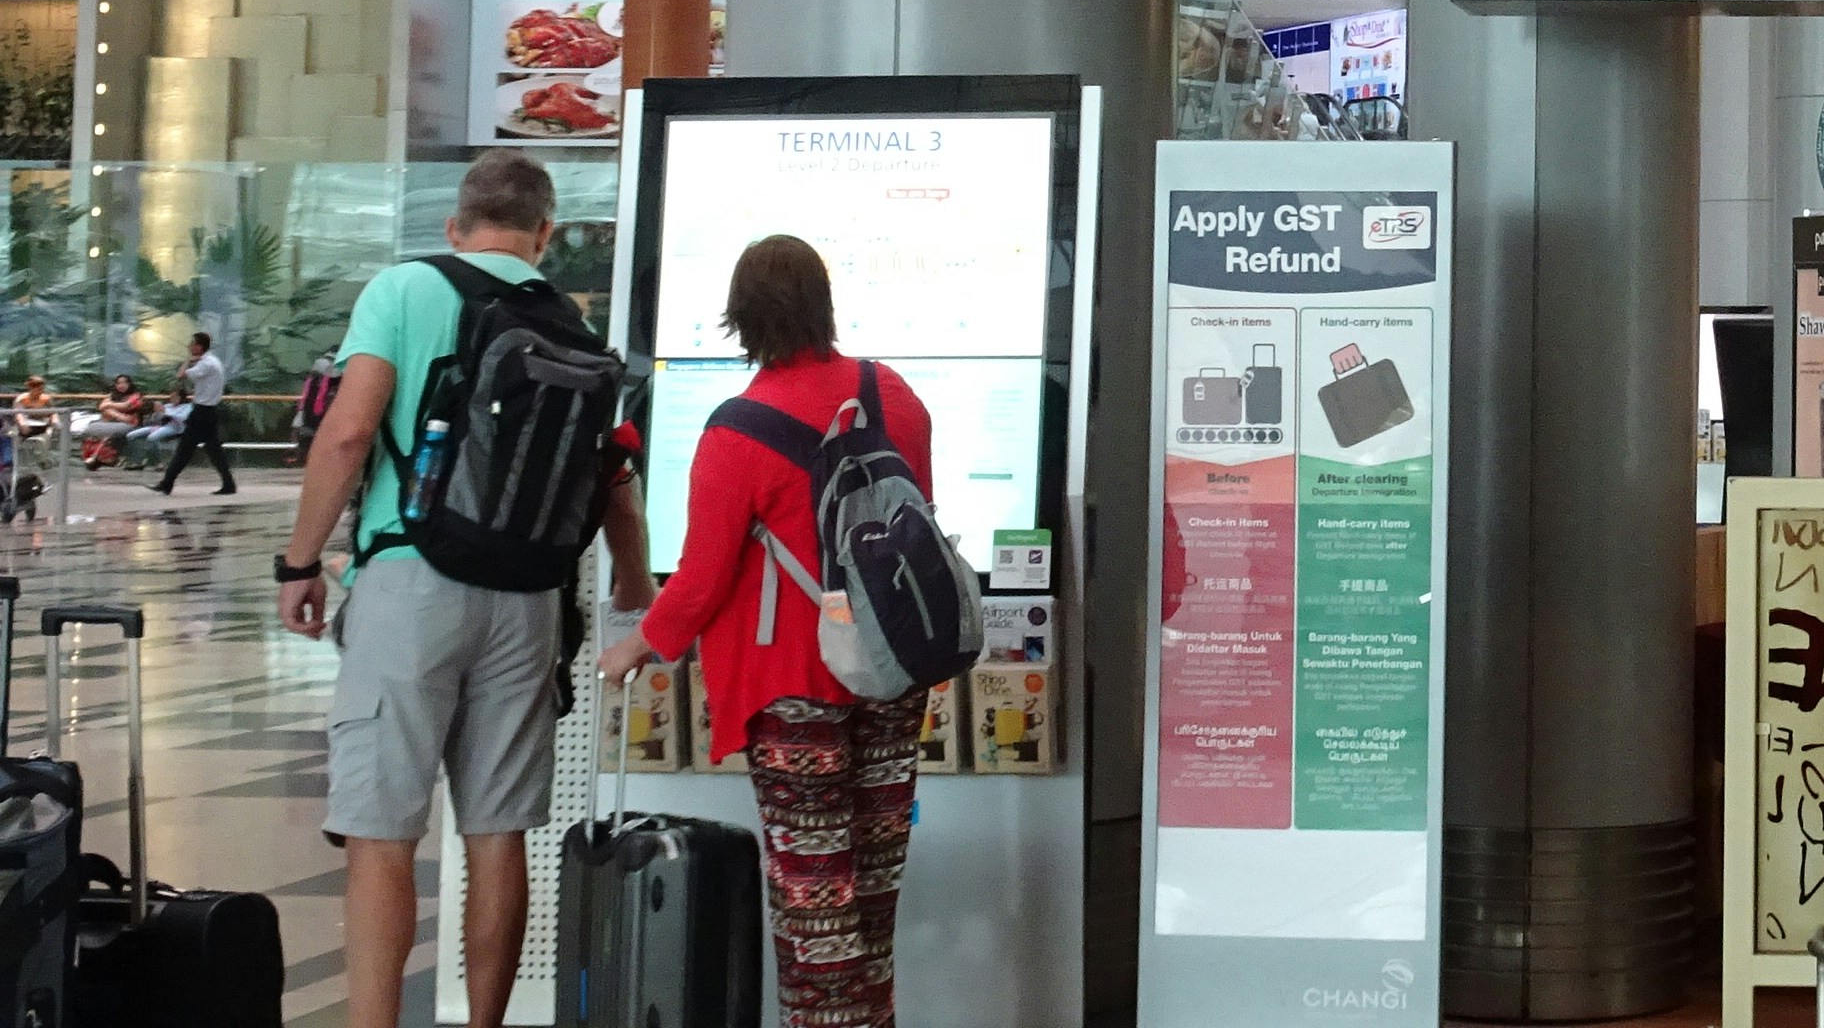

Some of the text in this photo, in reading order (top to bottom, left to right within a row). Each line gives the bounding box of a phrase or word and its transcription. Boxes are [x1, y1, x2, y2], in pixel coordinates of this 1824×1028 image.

[778, 132, 942, 152] TERMINAL 3
[779, 158, 940, 172] Level 2 Departure
[1174, 204, 1342, 237] Apply GST
[1226, 246, 1340, 272] Refund
[1191, 318, 1271, 326] Check-in items
[1320, 318, 1413, 328] Hand-carry items
[1207, 474, 1249, 484] Before
[1318, 474, 1408, 486] After clearing
[1312, 487, 1416, 497] Departure Immigration
[1188, 518, 1269, 527] Check-in items
[1318, 519, 1410, 530] Hand-carry items
[1169, 632, 1281, 642] Barang-barang Untuk
[1309, 633, 1417, 644] Barang-barang Yang
[1187, 645, 1266, 654] Didaftar Masuk
[1322, 646, 1403, 657] Dibawa Tangan
[1303, 659, 1422, 670] Sewaktu Penerbangan
[1303, 988, 1407, 1010] CHANGI
